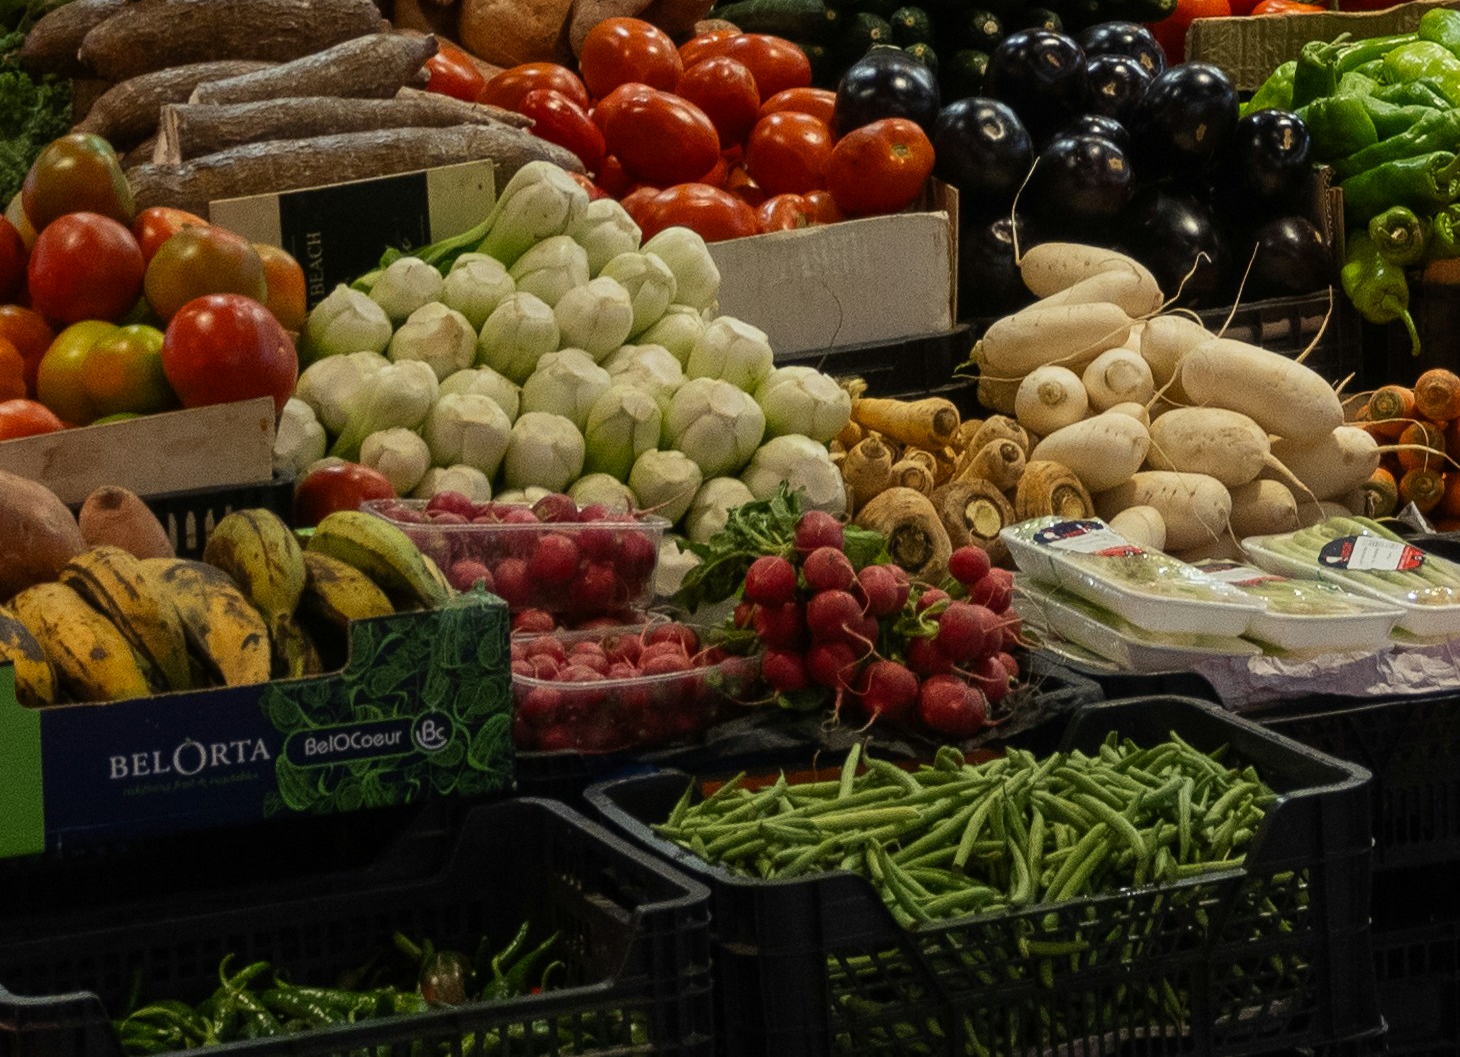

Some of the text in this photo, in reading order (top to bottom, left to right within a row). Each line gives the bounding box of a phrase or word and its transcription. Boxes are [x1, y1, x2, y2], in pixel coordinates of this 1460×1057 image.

[306, 231, 326, 297] BEACH
[109, 738, 271, 779] BELORTA
[304, 730, 402, 756] BelOCoeur
